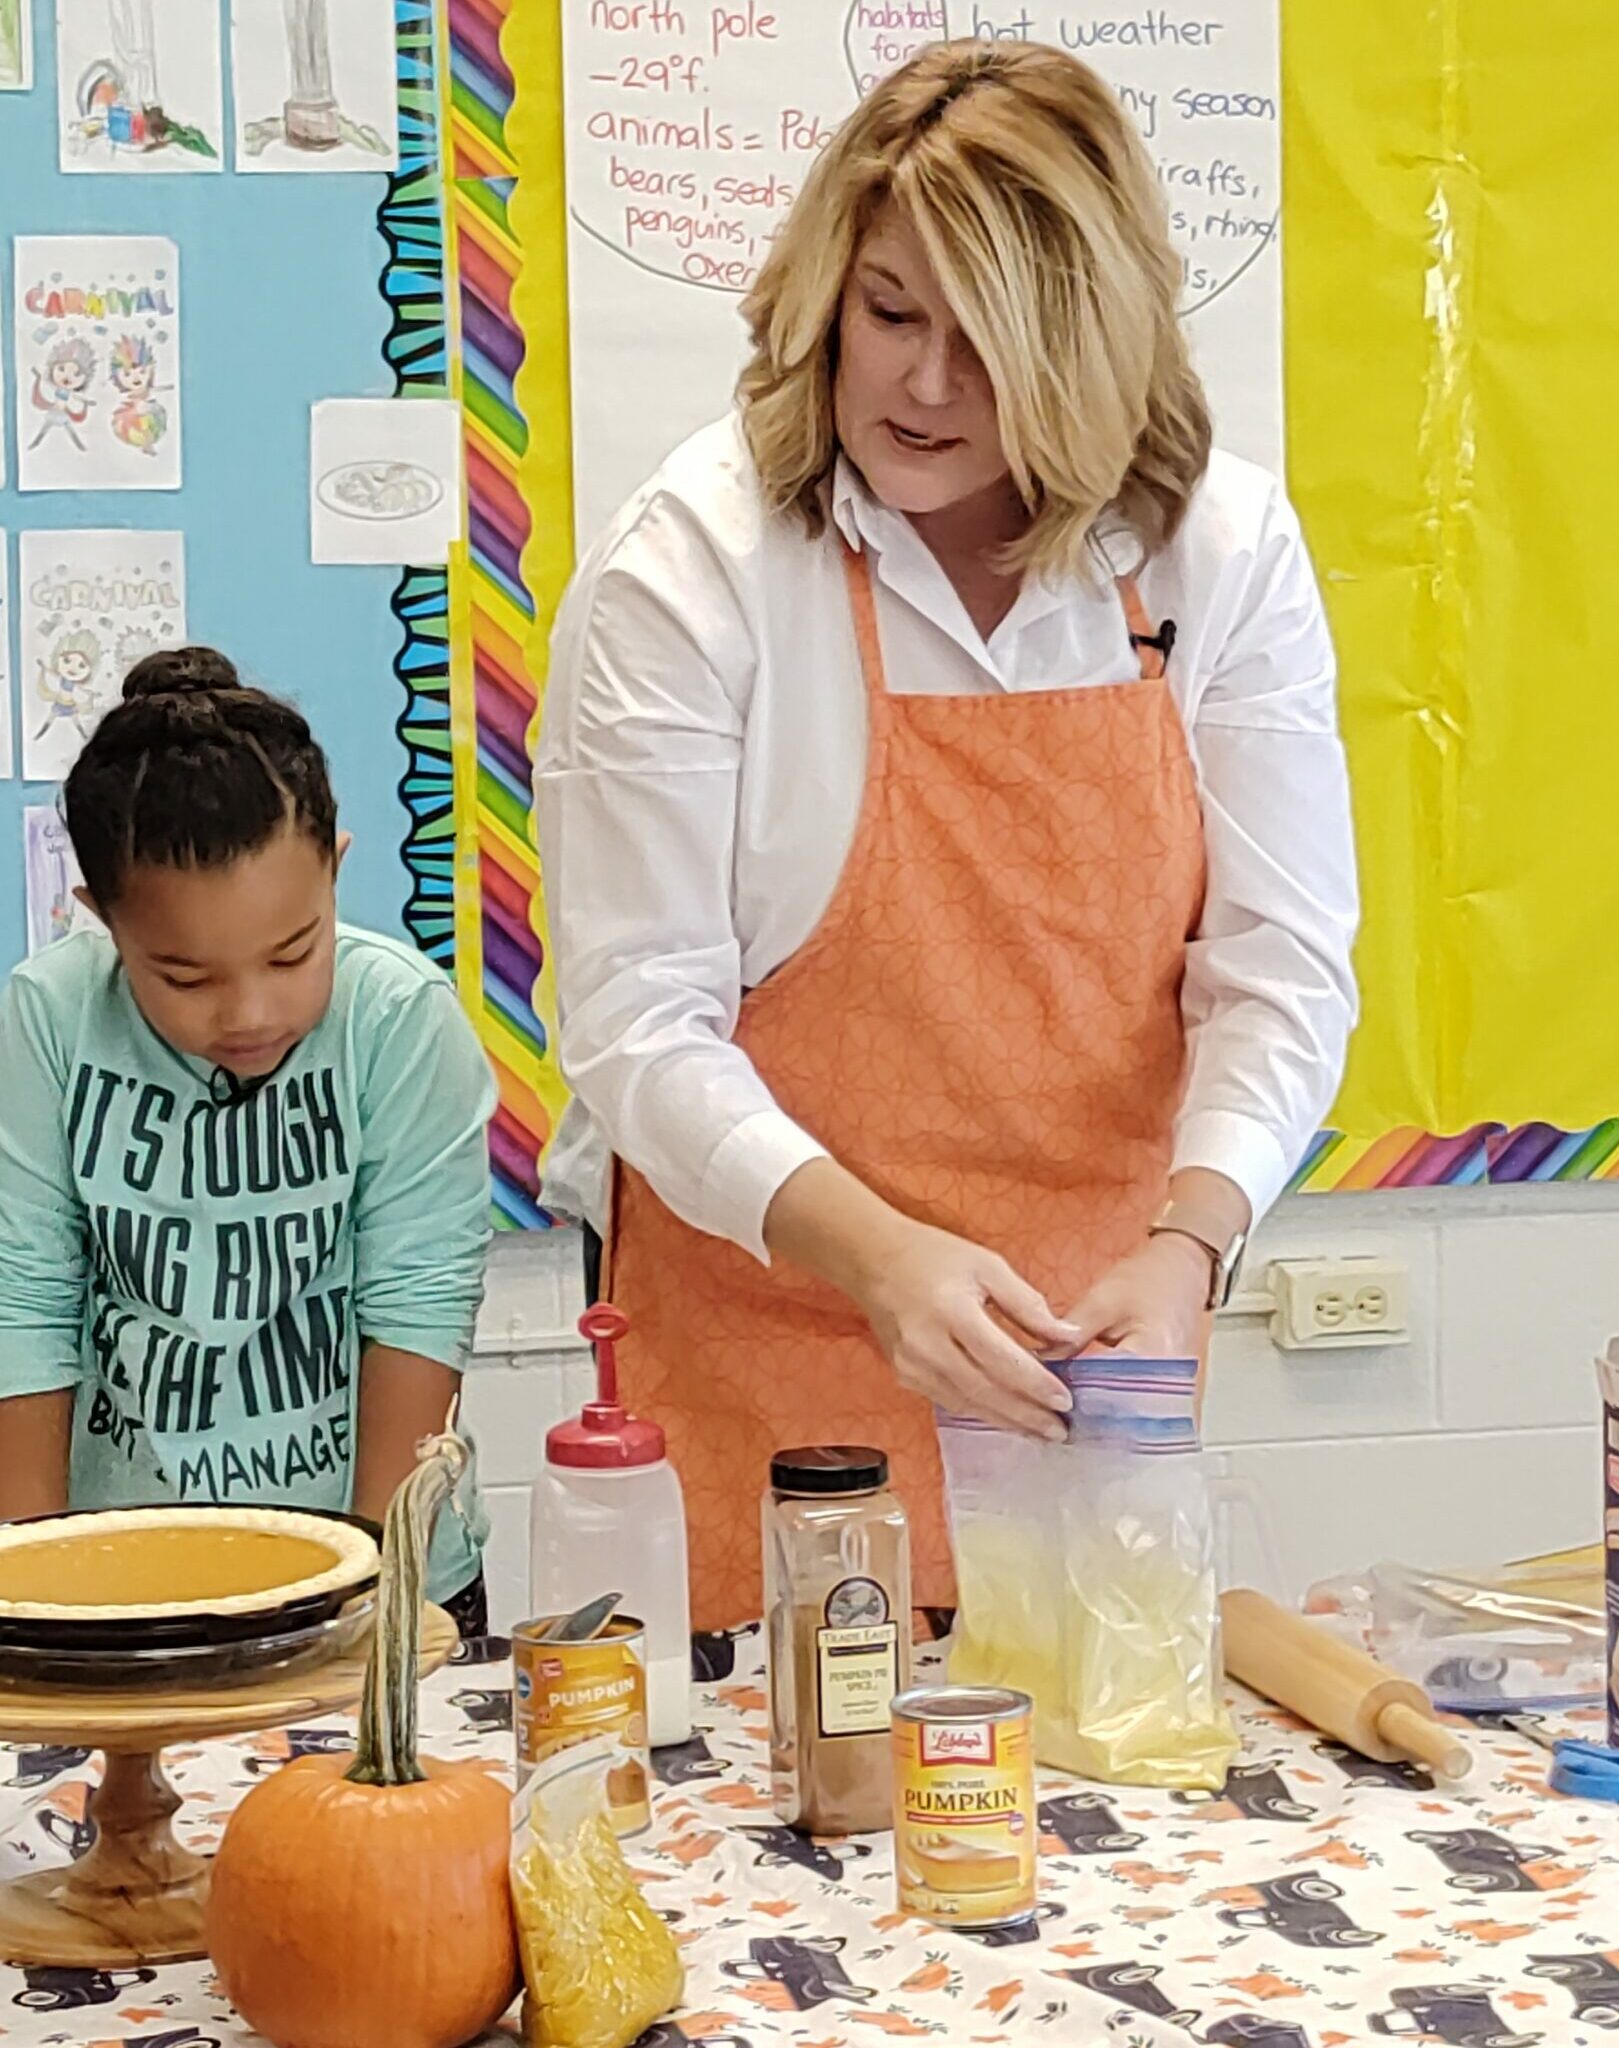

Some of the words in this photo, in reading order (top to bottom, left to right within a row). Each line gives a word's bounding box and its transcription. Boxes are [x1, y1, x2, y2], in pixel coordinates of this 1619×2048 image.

[591, 0, 685, 35] north
[711, 0, 779, 58] pole
[1059, 10, 1224, 49] weather
[870, 34, 917, 62] for
[1172, 87, 1276, 121] season
[587, 106, 734, 151] animals
[1156, 157, 1261, 199] iraffs,
[25, 286, 175, 320] CARNIVAL
[30, 579, 181, 613] CARNIVAL
[67, 1062, 177, 1193] IT'S
[178, 1410, 351, 1503] MANAGE
[548, 1676, 636, 1709] PUMPKIN
[904, 1786, 1018, 1812] PUMPKIN
